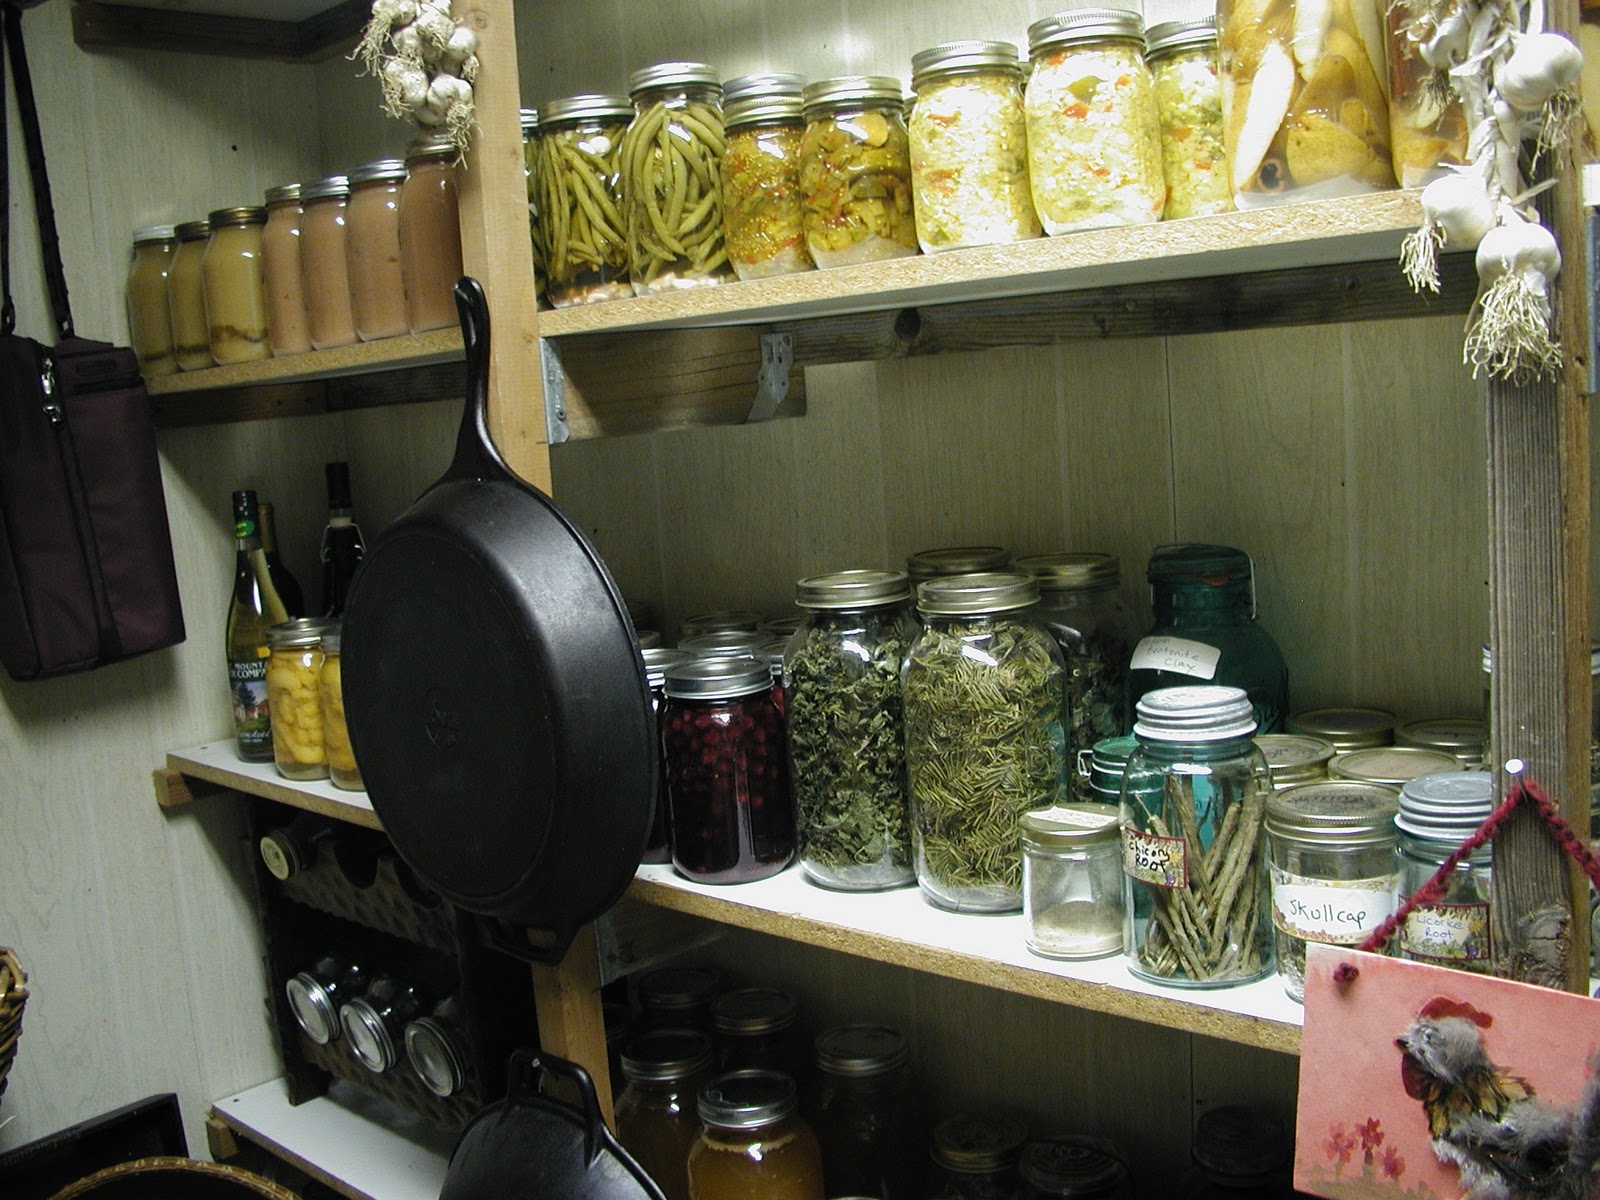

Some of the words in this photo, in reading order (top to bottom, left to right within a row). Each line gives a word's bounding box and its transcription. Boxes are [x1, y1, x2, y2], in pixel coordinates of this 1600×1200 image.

[234, 661, 267, 670] MOUNT
[1164, 658, 1196, 674] Clay
[237, 668, 266, 679] COMPA
[1290, 899, 1367, 930] Skullcap
[1416, 914, 1465, 930] Licorice
[1425, 926, 1454, 940] Root
